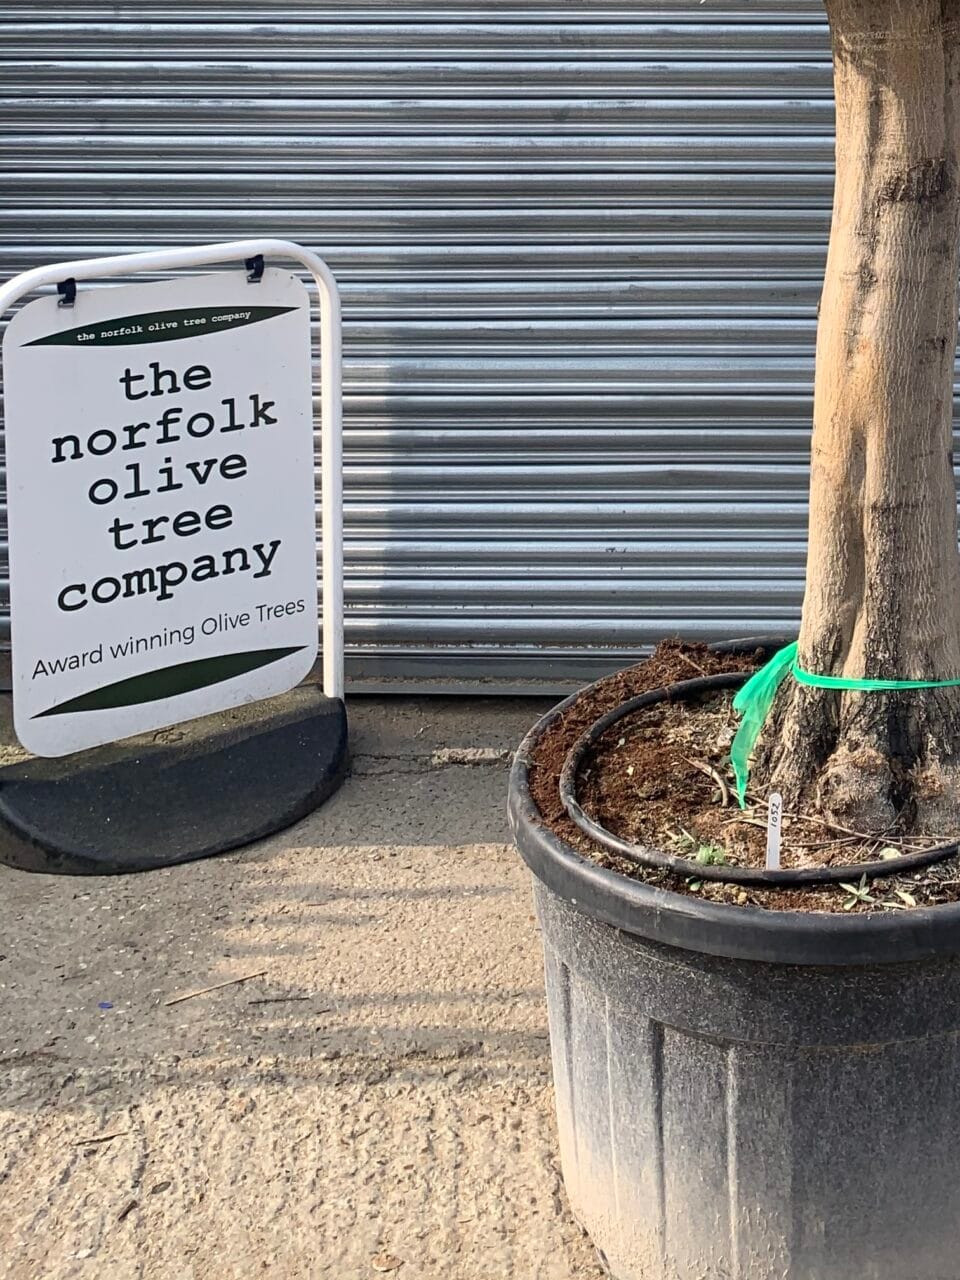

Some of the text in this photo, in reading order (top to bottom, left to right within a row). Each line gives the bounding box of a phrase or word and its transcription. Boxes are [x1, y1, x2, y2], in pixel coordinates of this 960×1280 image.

[76, 310, 252, 341] the norfolk olive tree company
[119, 362, 212, 401] the
[51, 394, 278, 464] norfolk
[88, 454, 247, 505] olive
[108, 504, 233, 550] tree
[57, 540, 282, 612] company
[31, 599, 305, 680] Award winning Olive Trees
[770, 802, 780, 827] 1052
